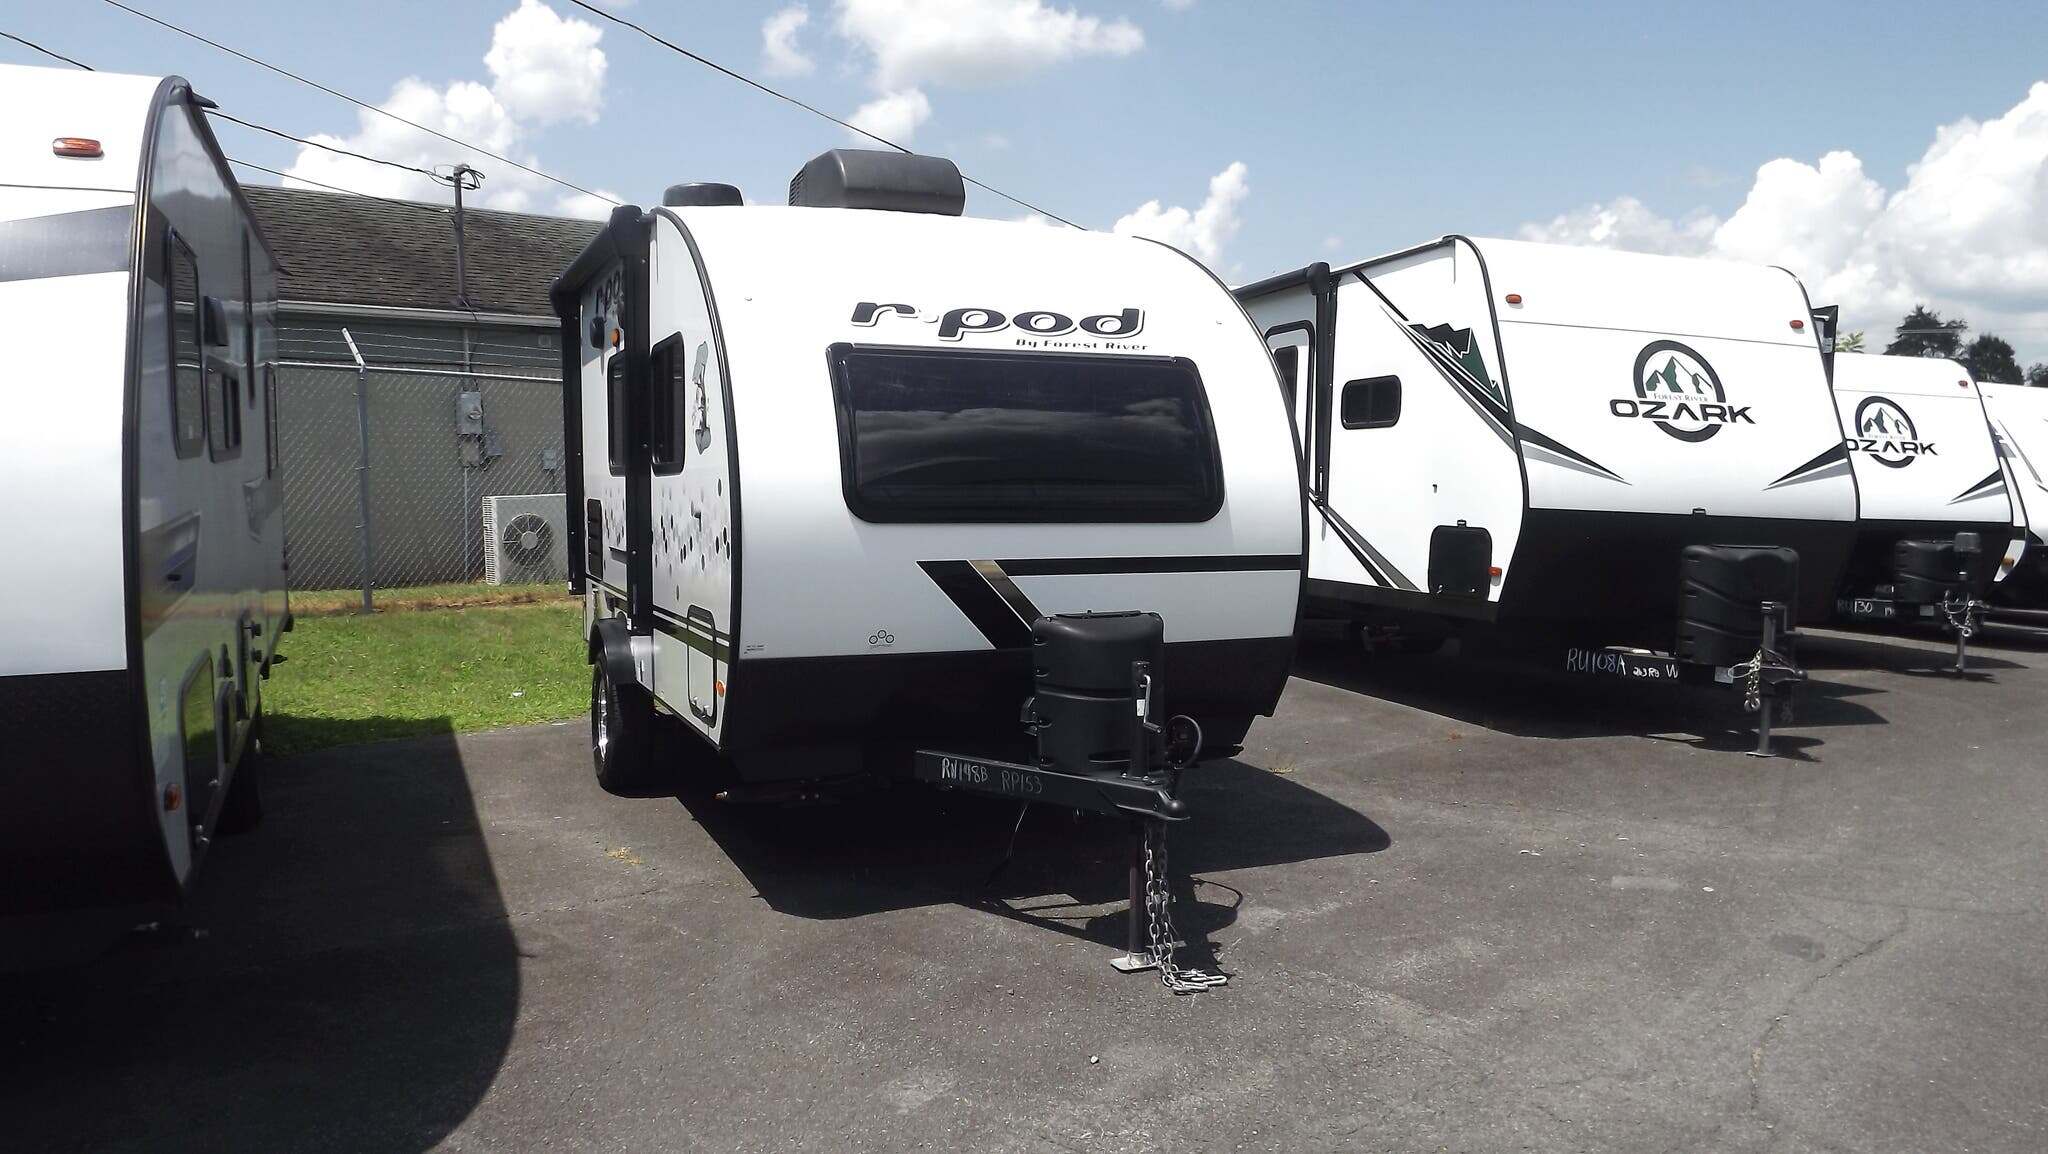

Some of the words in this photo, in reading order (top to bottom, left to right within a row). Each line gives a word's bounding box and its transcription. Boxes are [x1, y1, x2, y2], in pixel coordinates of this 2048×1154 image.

[1016, 339, 1038, 348] By
[1044, 340, 1098, 349] Forest
[1105, 342, 1149, 351] River
[1609, 399, 1757, 424] OZARK
